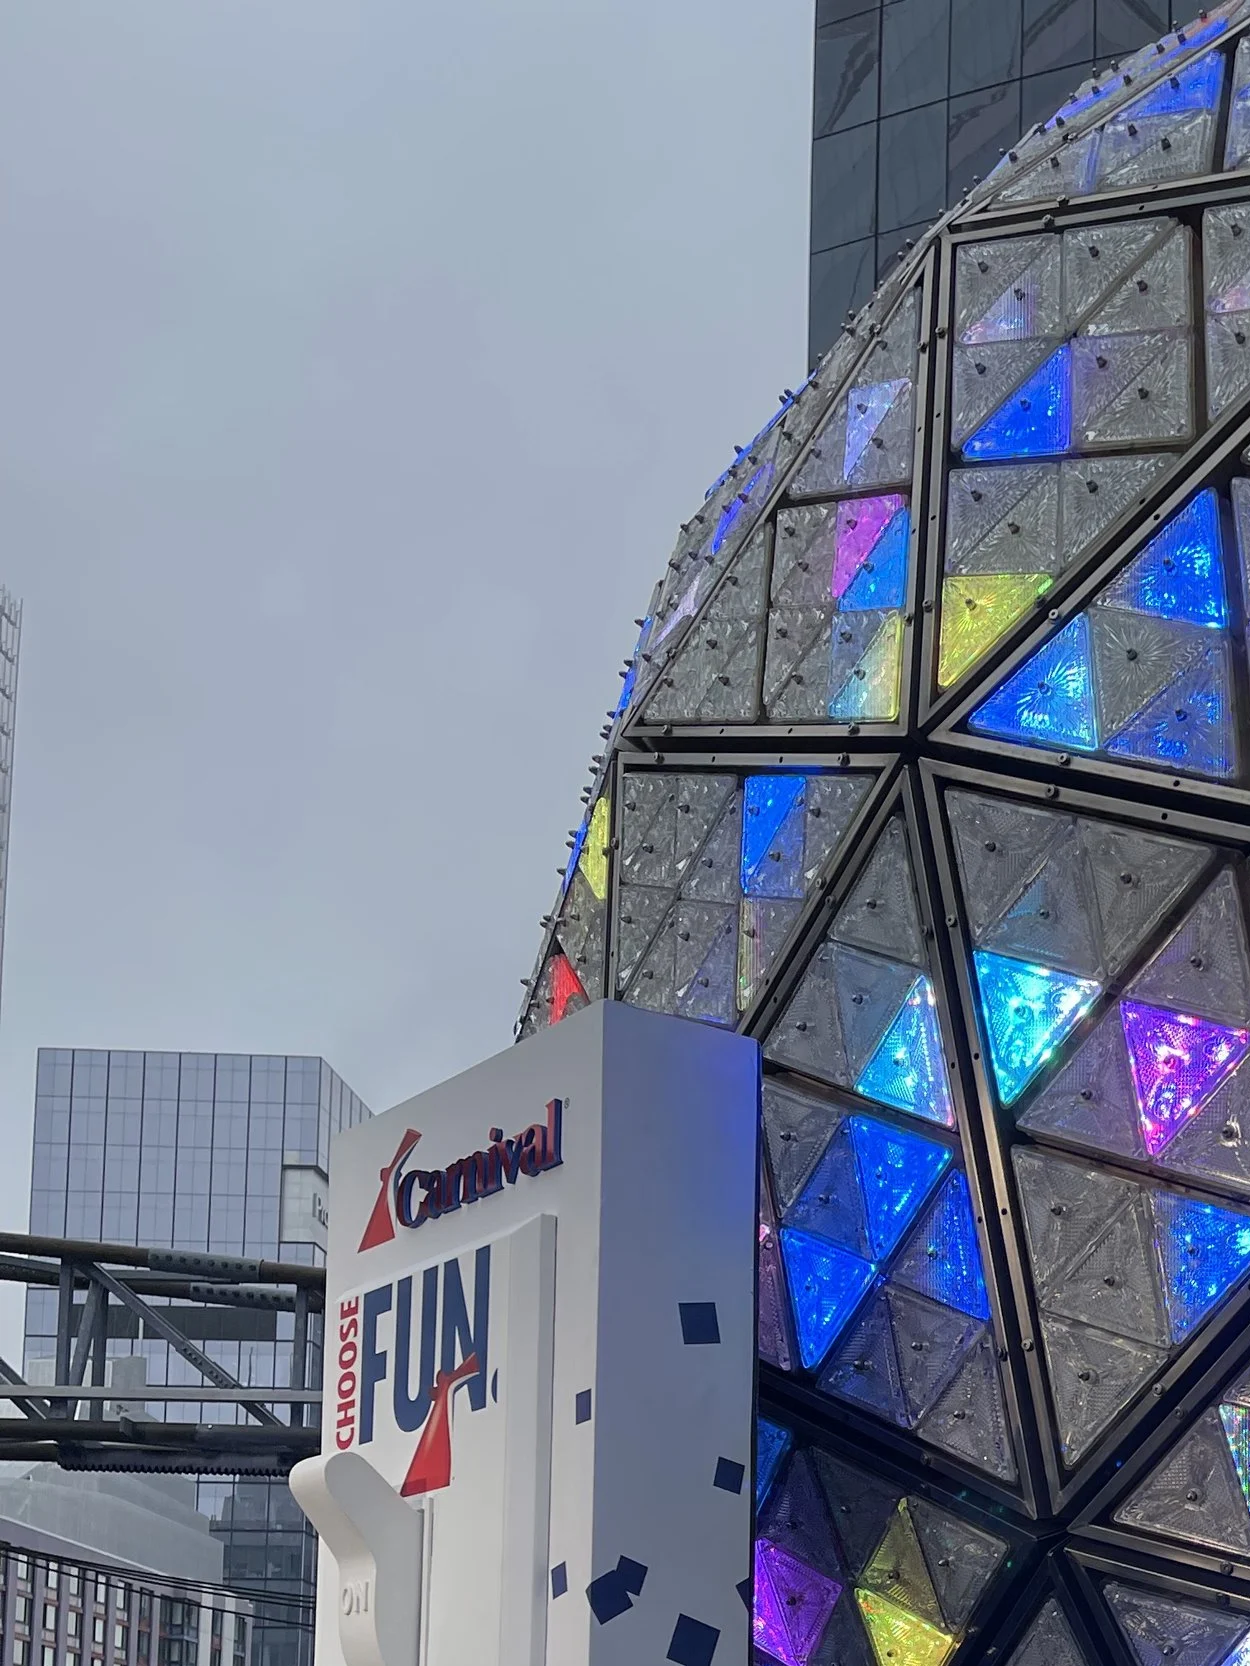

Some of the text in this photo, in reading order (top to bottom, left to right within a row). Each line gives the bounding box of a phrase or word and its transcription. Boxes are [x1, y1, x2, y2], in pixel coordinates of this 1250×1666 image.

[396, 1098, 563, 1229] Carnival
[336, 1295, 359, 1450] CHOOSE
[342, 1580, 370, 1616] ON
